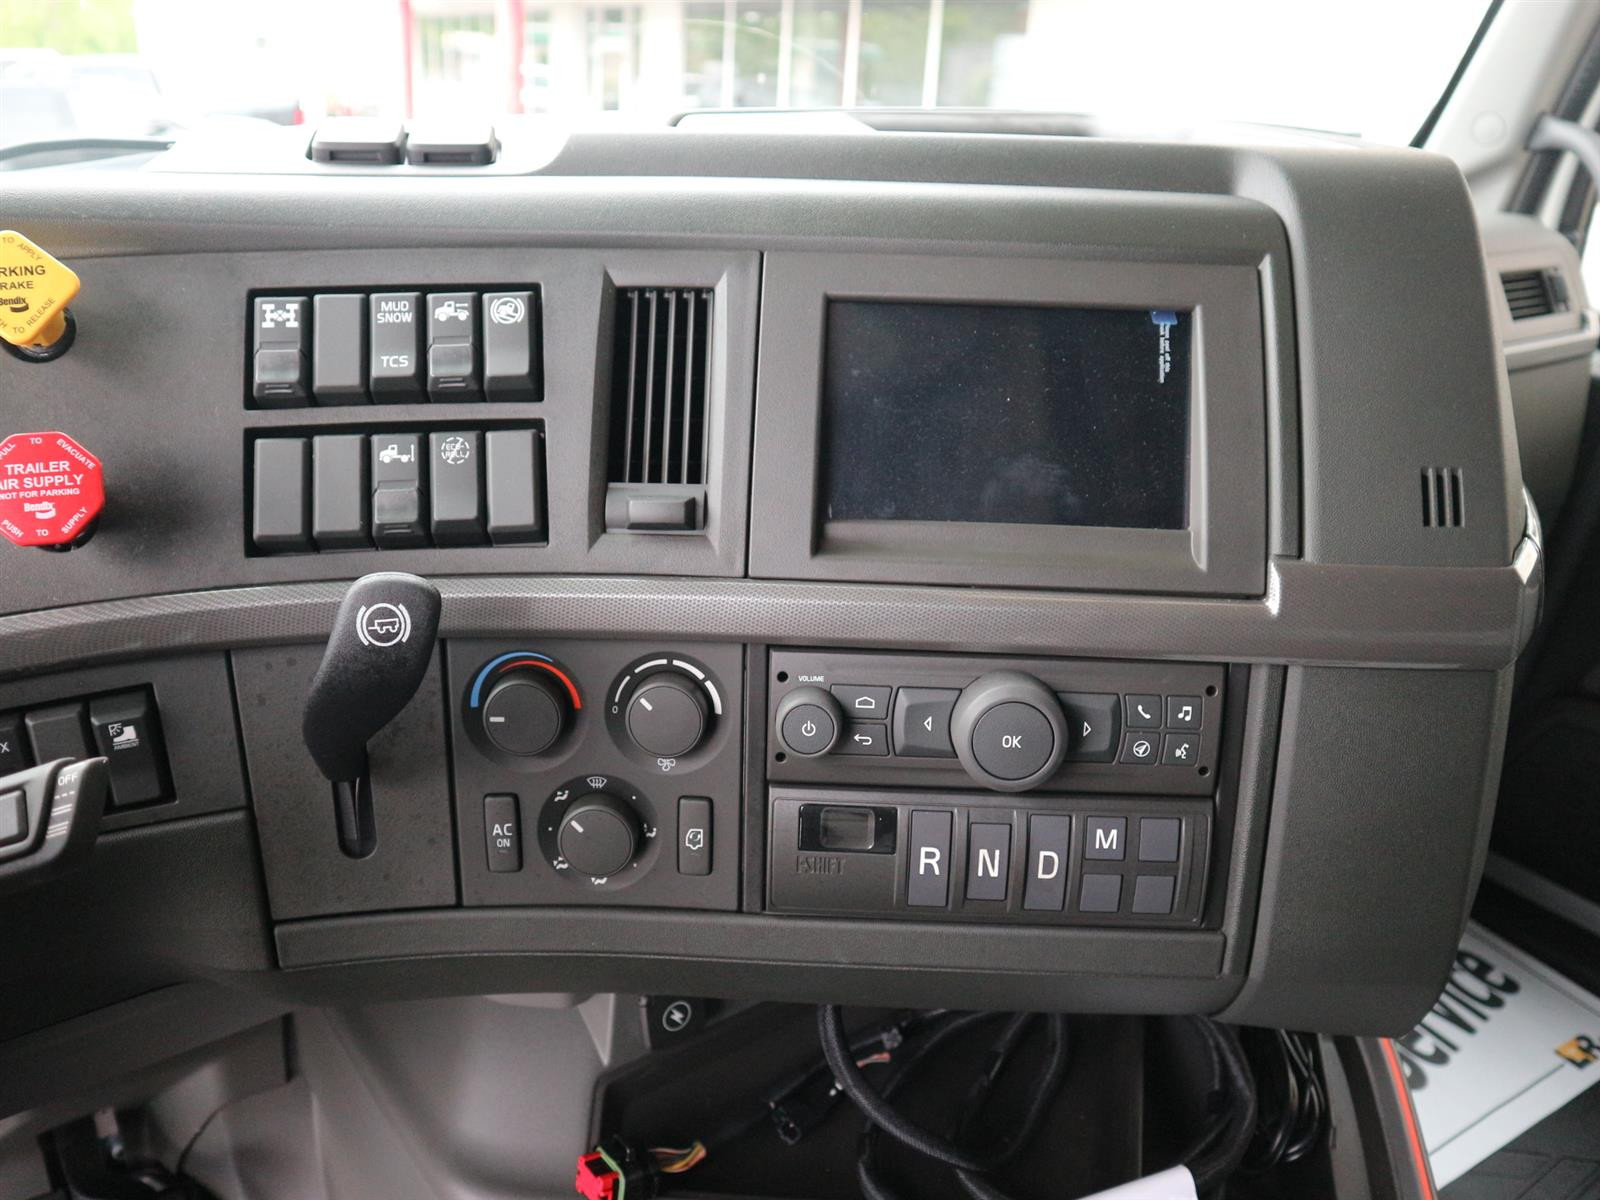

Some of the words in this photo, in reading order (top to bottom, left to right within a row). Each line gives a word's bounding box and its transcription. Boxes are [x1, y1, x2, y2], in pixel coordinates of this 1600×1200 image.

[26, 297, 56, 327] RELEASE
[381, 301, 409, 312] MUD
[376, 312, 413, 323] SNOW
[380, 355, 409, 368] TCS
[29, 437, 43, 445] TO
[56, 438, 97, 470] EVACUATE
[4, 460, 71, 475] TRAILER
[23, 473, 84, 488] SUPPLY
[19, 490, 38, 499] FOR
[40, 487, 80, 497] PARKING
[1, 519, 24, 538] PUSH
[35, 529, 49, 537] TO
[61, 506, 88, 534] SUPPLY
[1001, 735, 1022, 748] OK
[57, 774, 78, 786] OFF
[492, 823, 513, 836] AC
[496, 838, 511, 848] ON
[1095, 828, 1118, 850] M
[919, 846, 941, 876] R
[977, 848, 1000, 878] N
[1037, 850, 1060, 879] D
